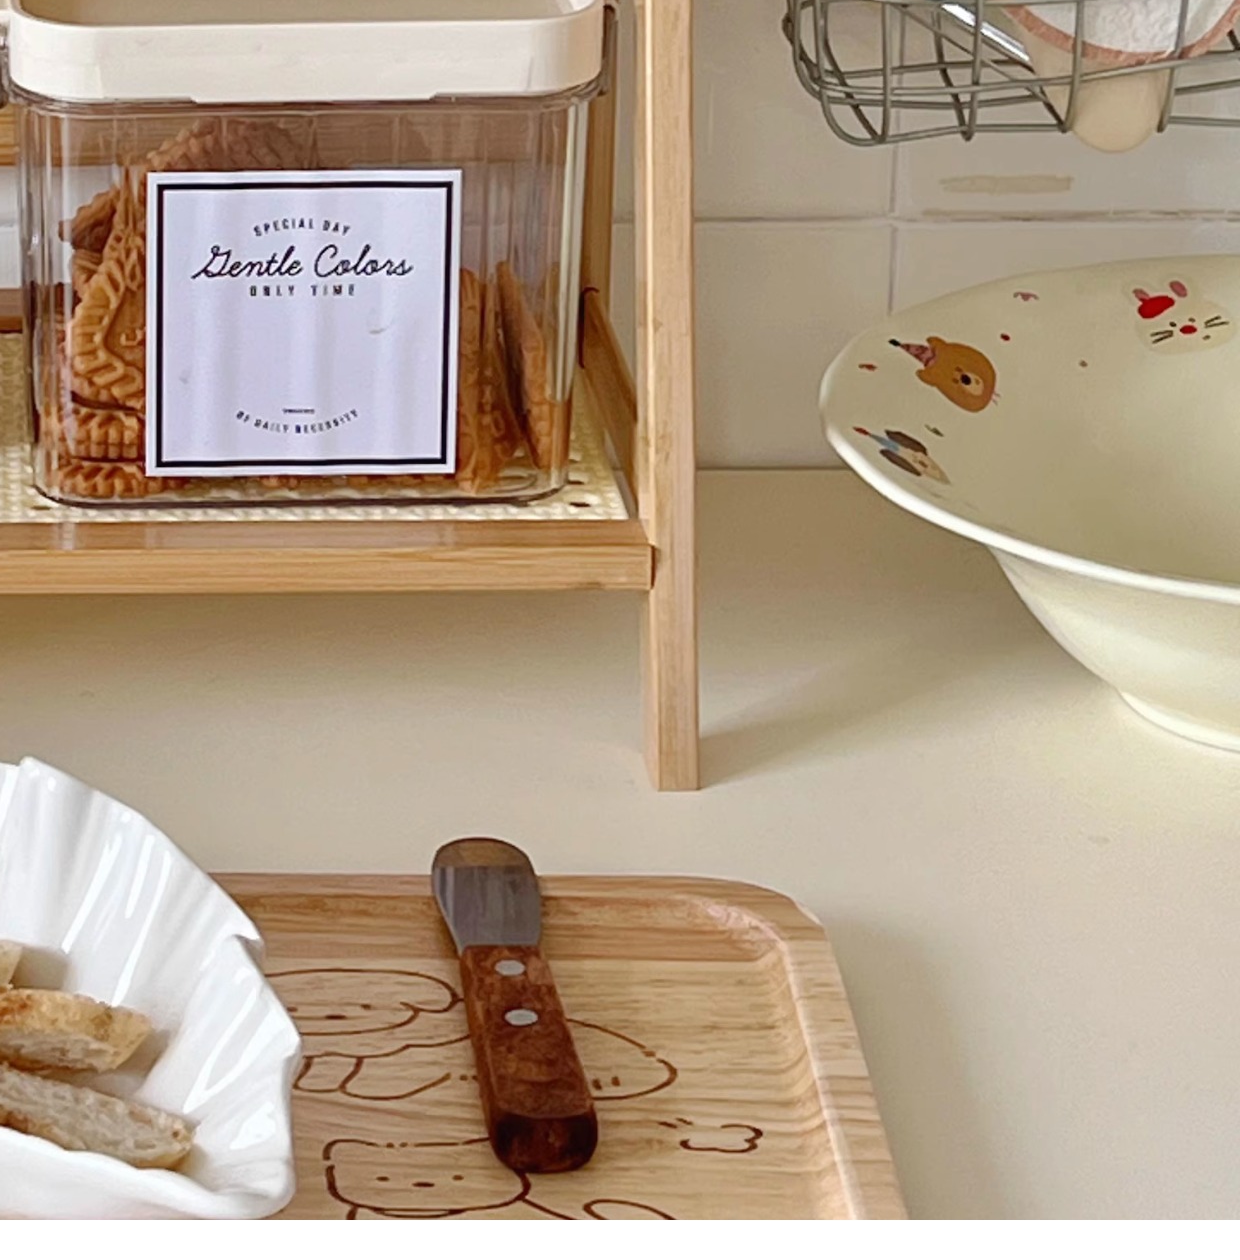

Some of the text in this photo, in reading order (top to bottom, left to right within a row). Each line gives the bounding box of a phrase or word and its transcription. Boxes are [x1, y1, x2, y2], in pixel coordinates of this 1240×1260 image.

[254, 218, 351, 237] SPECIAL DAY
[191, 244, 414, 279] Gentle Colors
[250, 284, 355, 297] ONLY TIME
